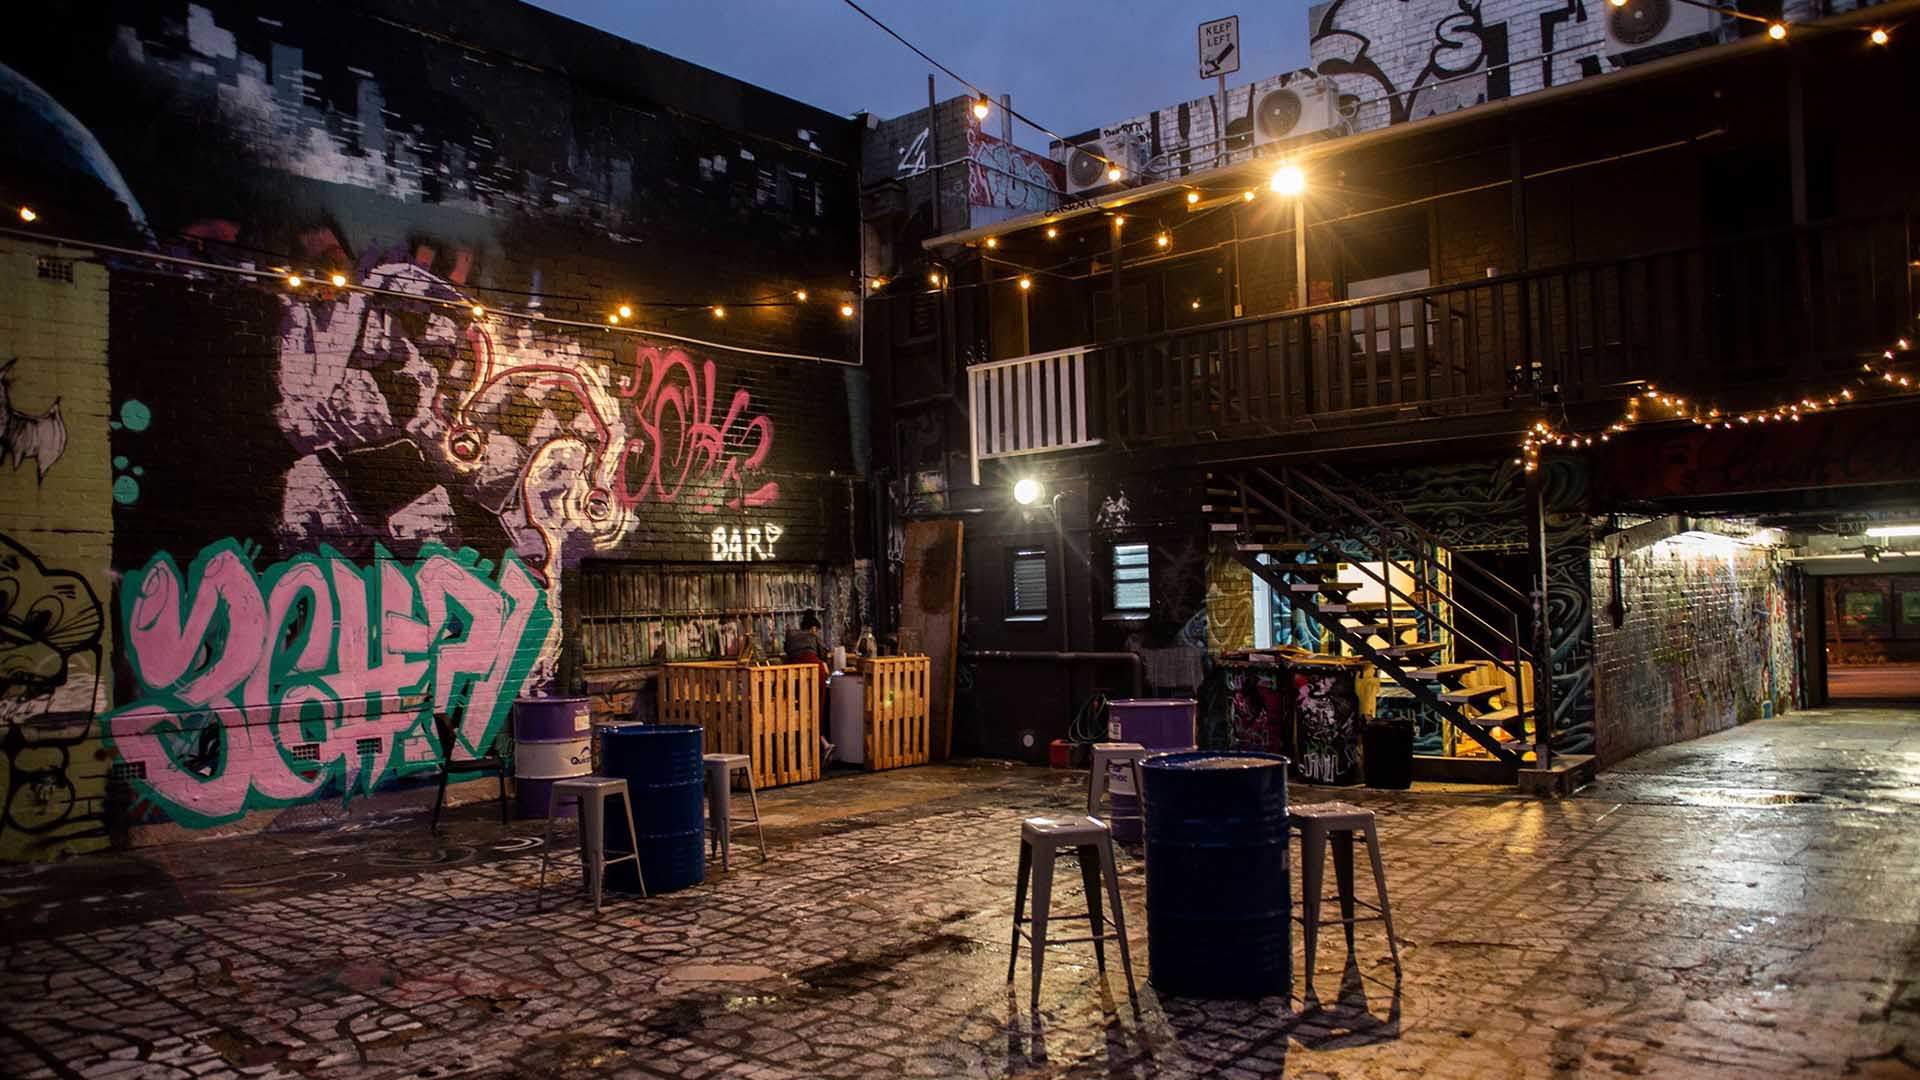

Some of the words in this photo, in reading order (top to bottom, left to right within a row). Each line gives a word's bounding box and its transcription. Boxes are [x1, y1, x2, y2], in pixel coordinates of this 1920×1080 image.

[1206, 21, 1232, 36] KEEP
[1207, 33, 1230, 47] LEFT
[1839, 519, 1865, 533] EXIT
[711, 525, 767, 562] BAR
